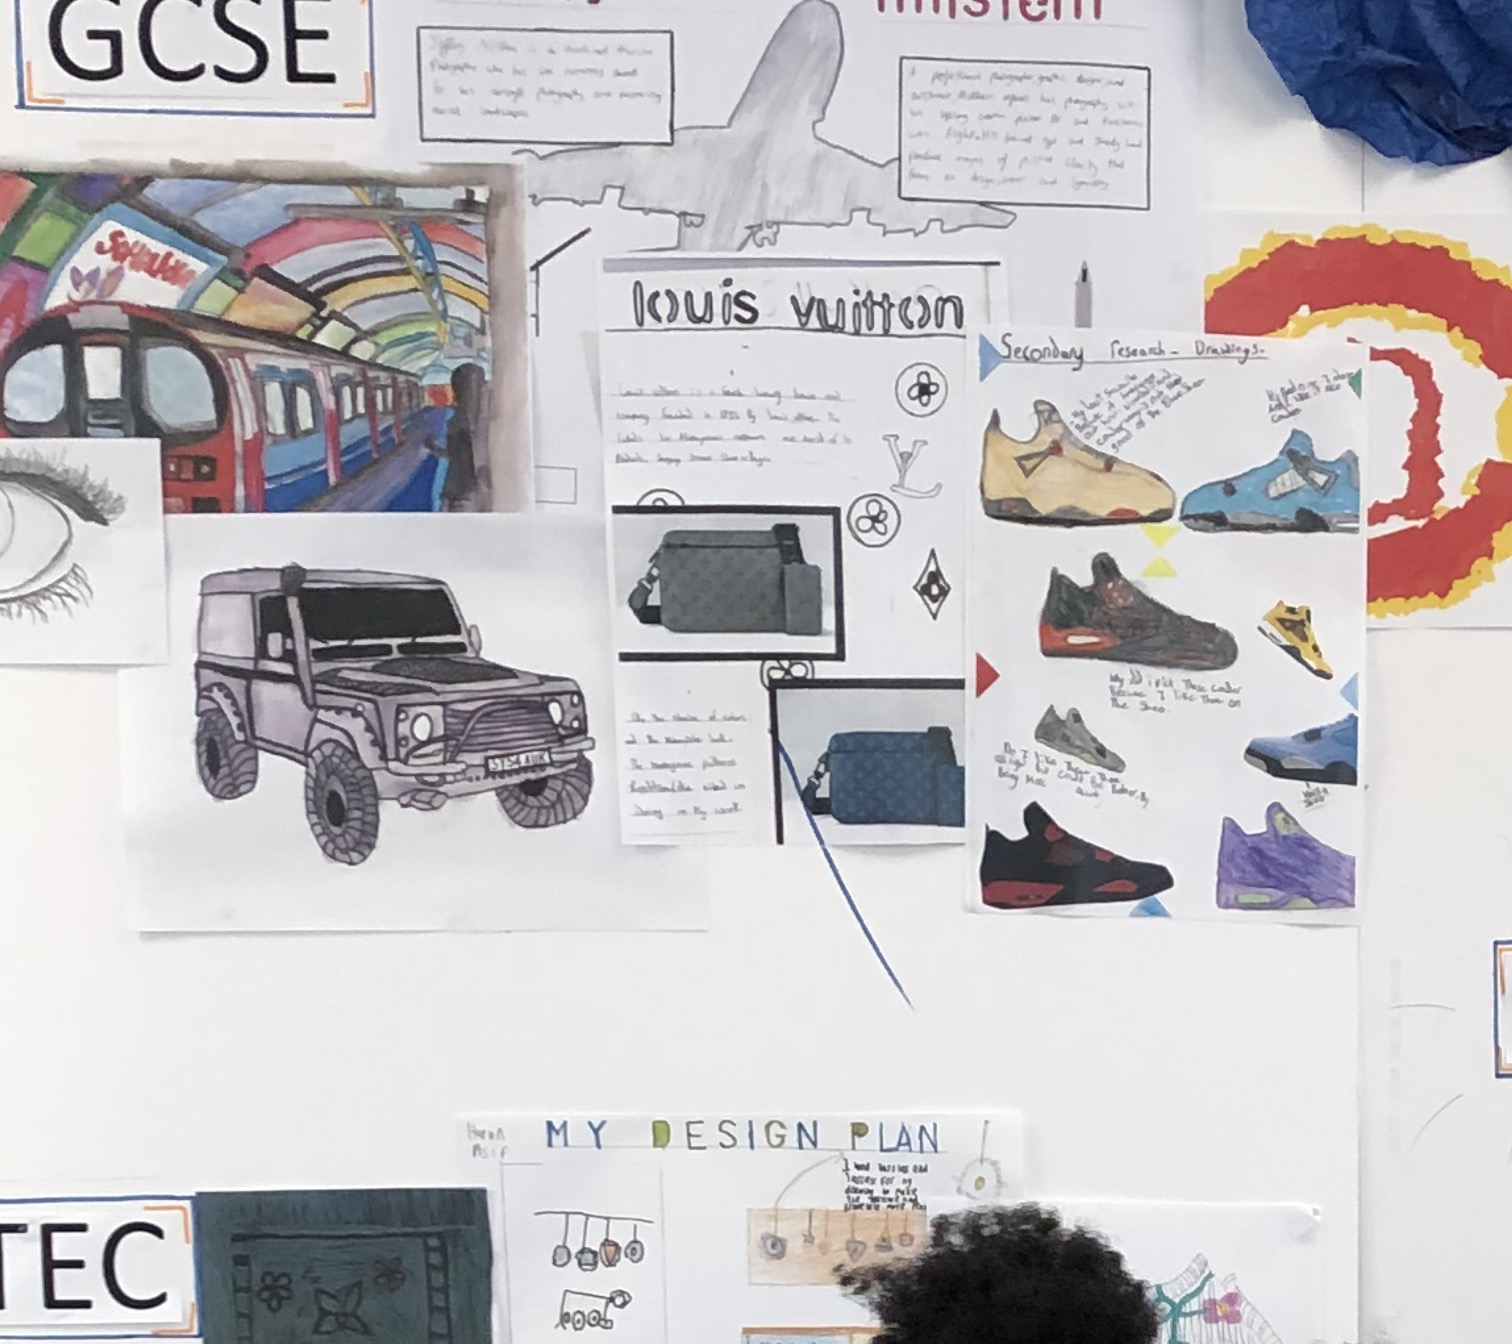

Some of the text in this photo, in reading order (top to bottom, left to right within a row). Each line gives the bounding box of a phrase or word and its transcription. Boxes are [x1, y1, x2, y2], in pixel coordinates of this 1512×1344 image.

[48, 0, 336, 84] GCSE
[632, 278, 965, 335] louis vuitton
[1000, 332, 1084, 371] Secondary
[1109, 339, 1166, 360] research
[547, 1119, 940, 1154] MY DESIGN PLAN
